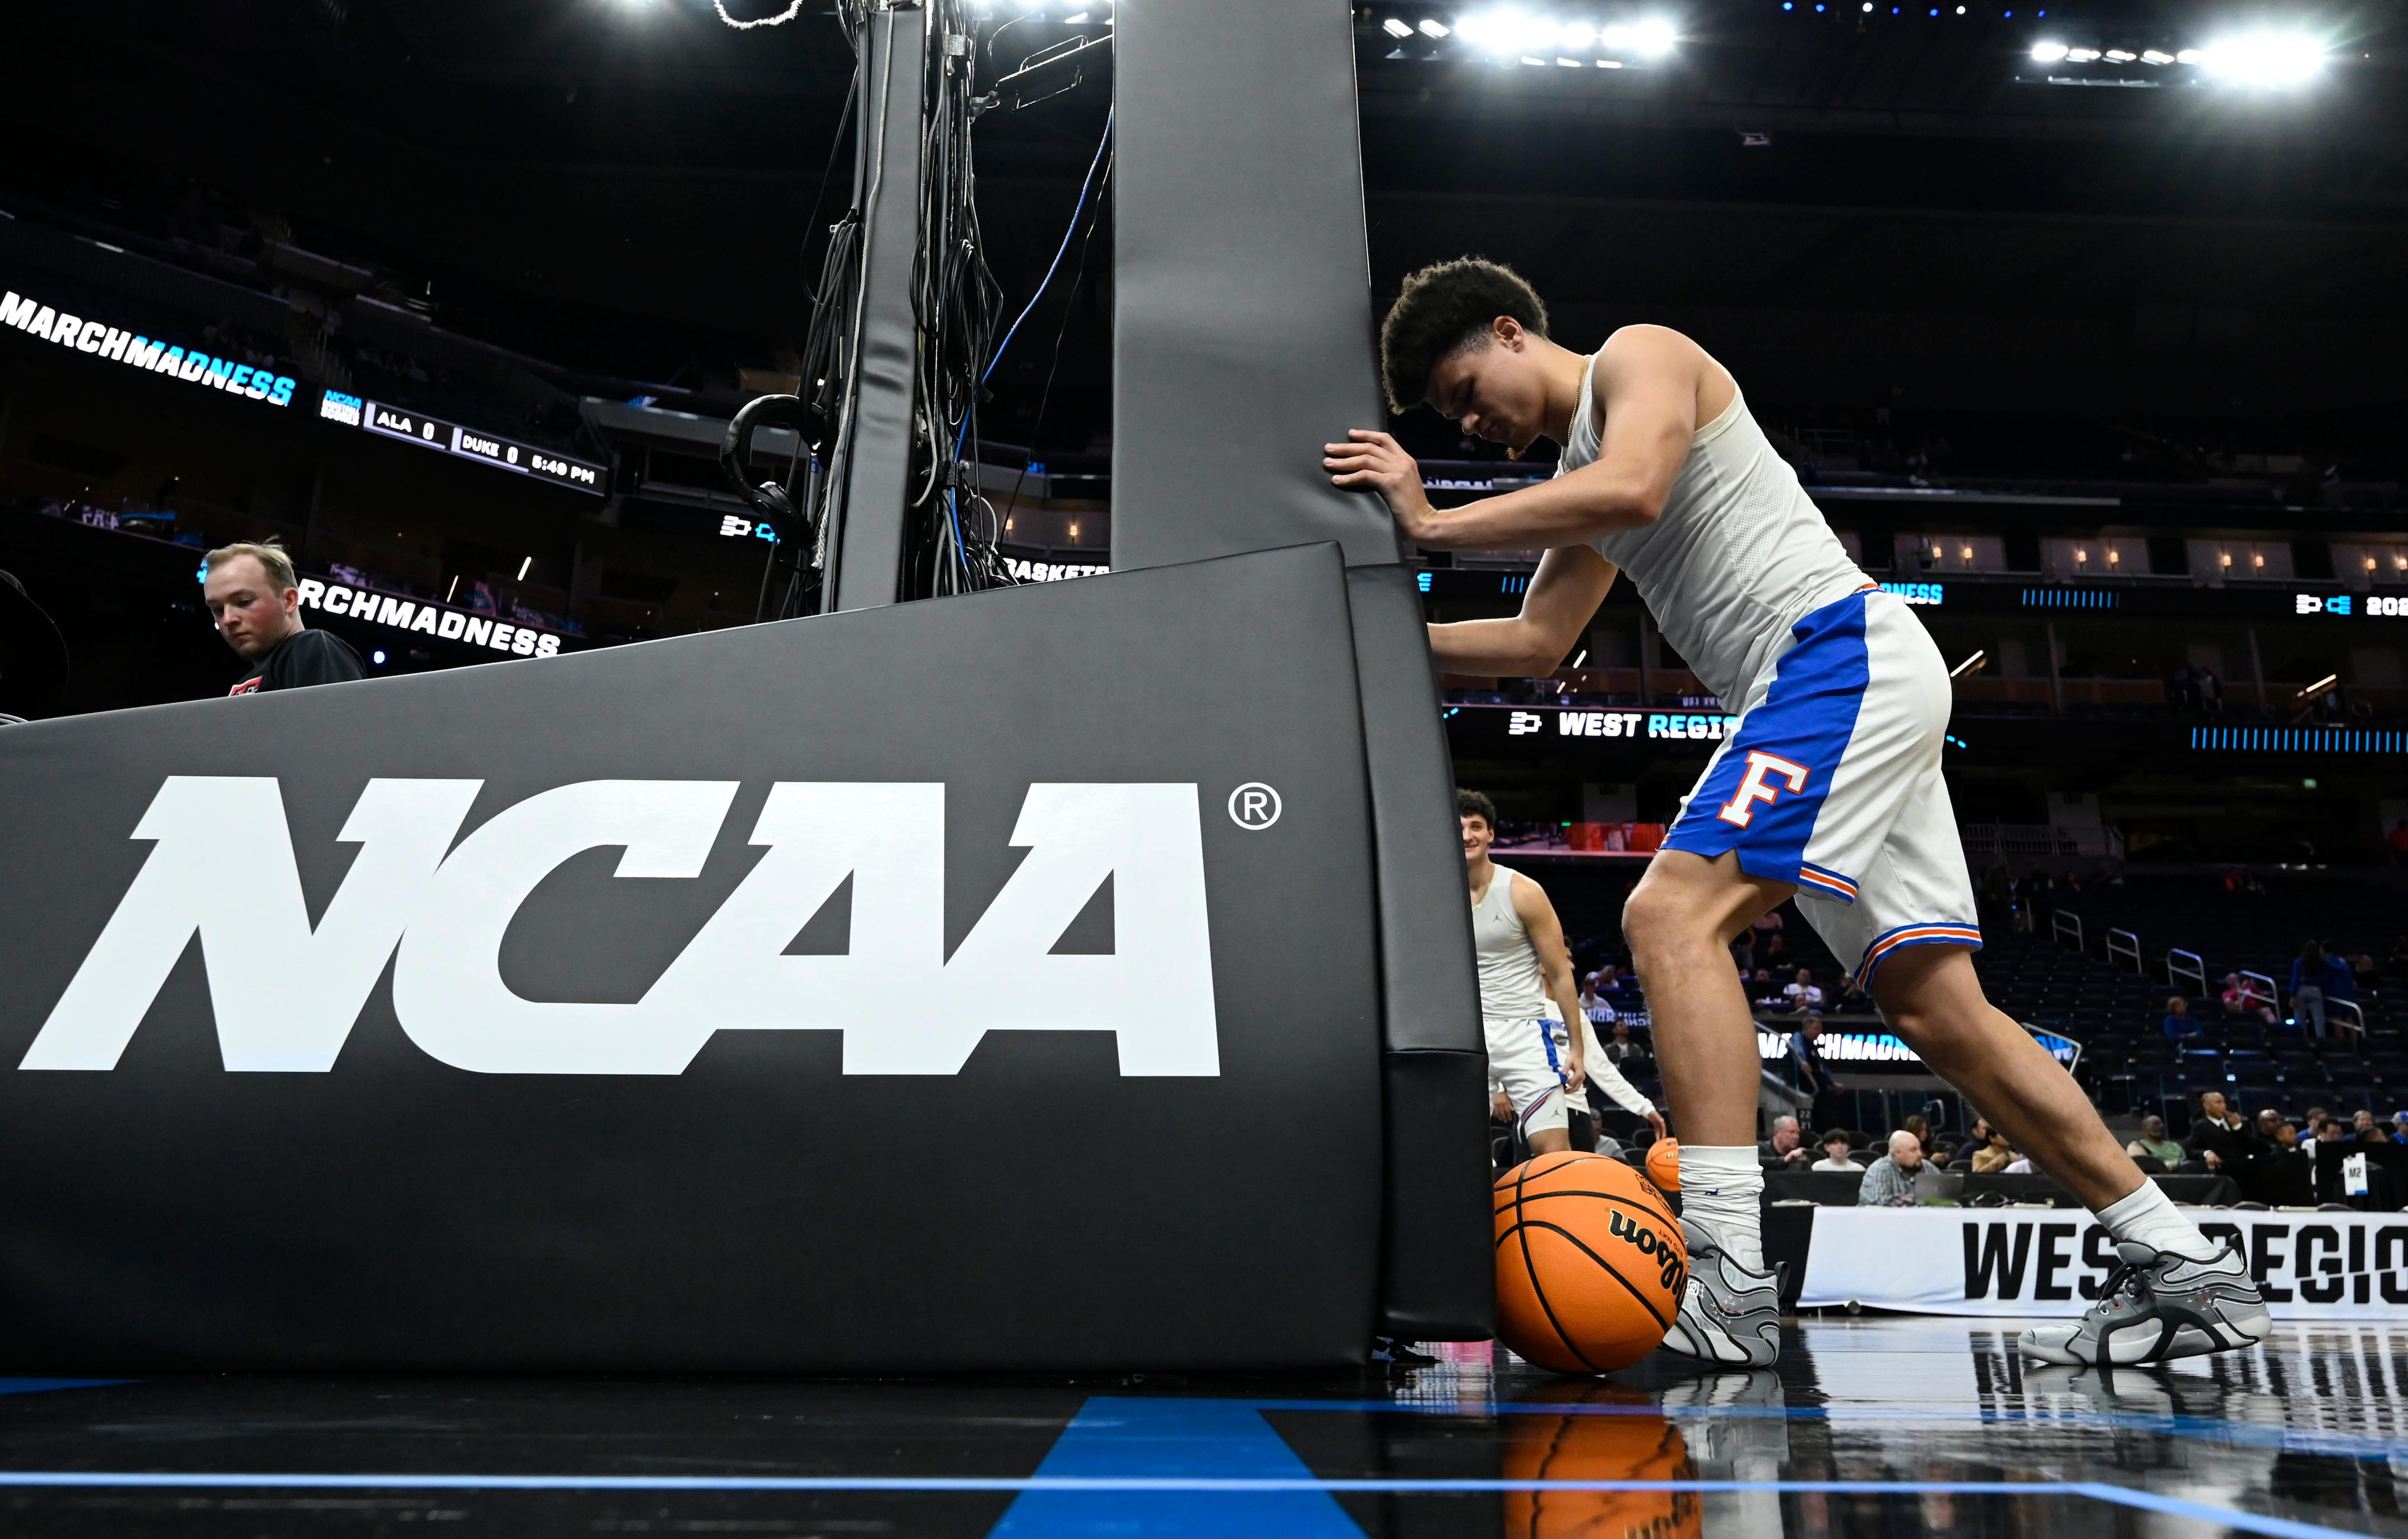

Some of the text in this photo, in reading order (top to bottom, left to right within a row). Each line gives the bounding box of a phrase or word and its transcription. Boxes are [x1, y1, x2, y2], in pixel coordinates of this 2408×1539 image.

[0, 291, 295, 406] MARCHMADNESS
[324, 390, 362, 410] NCAA
[377, 412, 412, 433] ALA
[423, 423, 435, 440] 0
[462, 435, 500, 457] DUKE
[507, 447, 518, 464] 0
[571, 466, 595, 484] PM
[1559, 712, 1642, 737] WEST
[1717, 749, 1812, 830] F
[17, 776, 1220, 1077] NCAA
[2349, 1167, 2361, 1178] M2
[1658, 1229, 1673, 1245] NXT
[1962, 1222, 2119, 1300] WES
